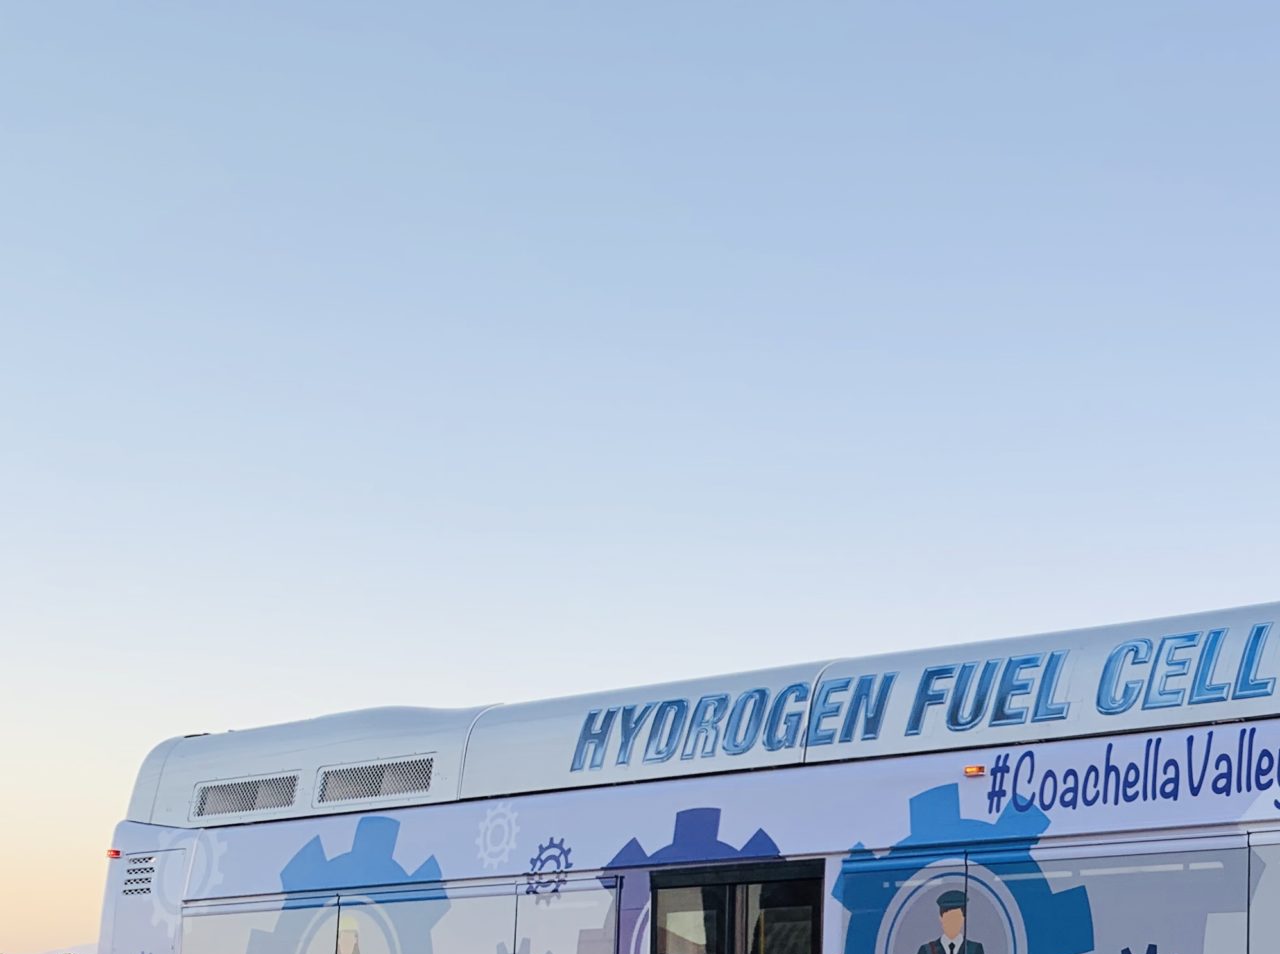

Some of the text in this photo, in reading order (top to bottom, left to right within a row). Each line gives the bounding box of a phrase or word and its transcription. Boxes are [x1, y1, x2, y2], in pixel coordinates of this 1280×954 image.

[569, 621, 1277, 773] HYDROGEN FUEL CELL
